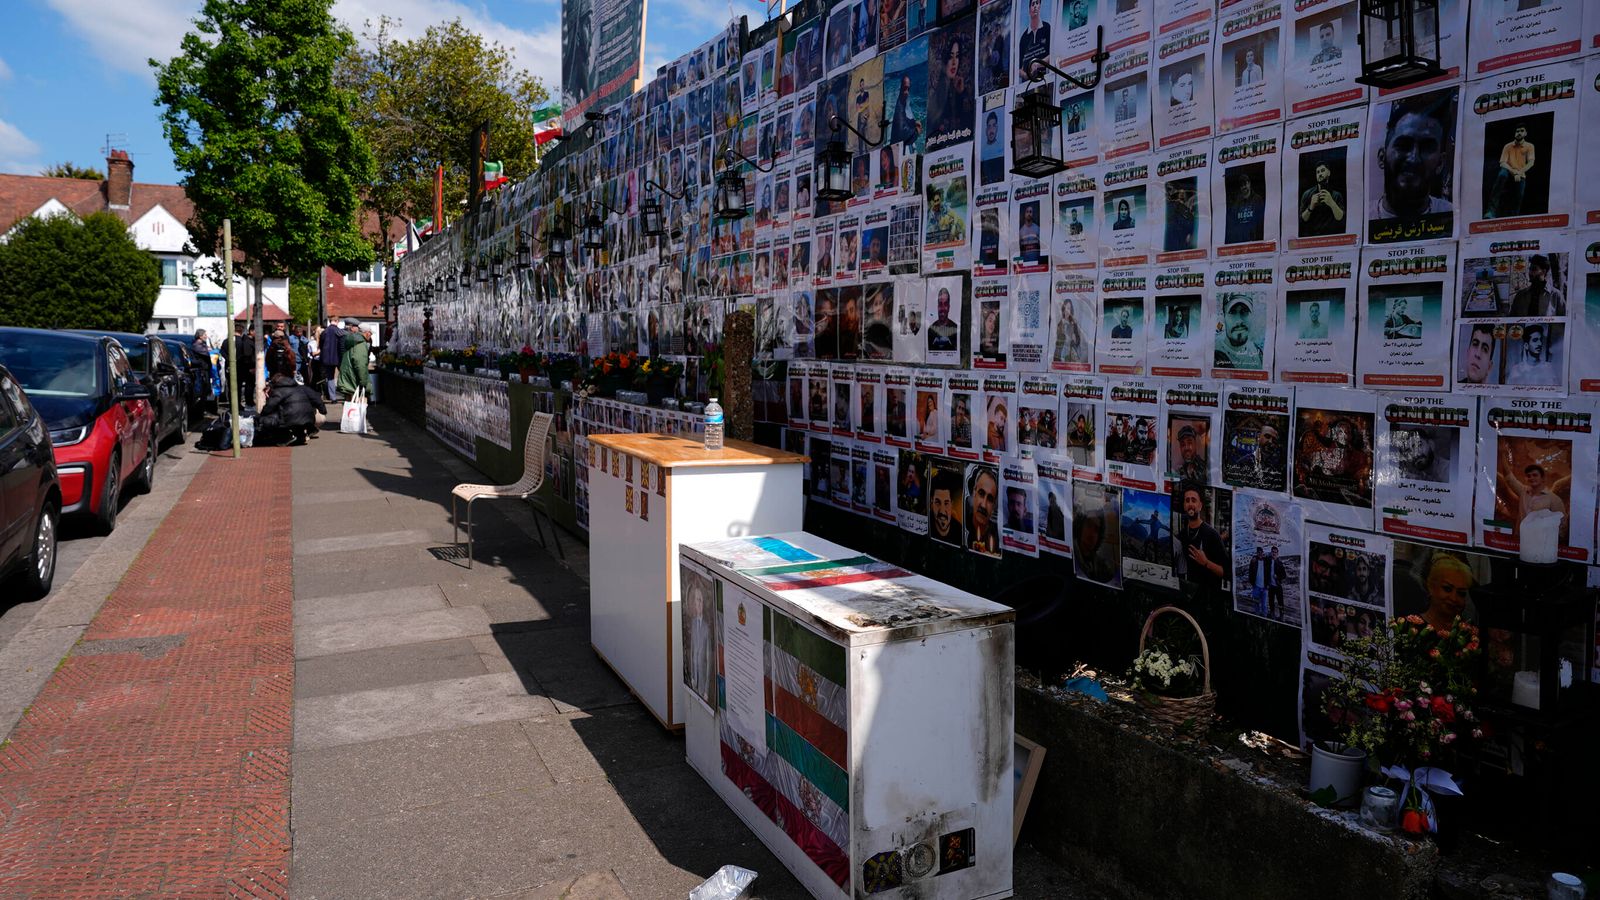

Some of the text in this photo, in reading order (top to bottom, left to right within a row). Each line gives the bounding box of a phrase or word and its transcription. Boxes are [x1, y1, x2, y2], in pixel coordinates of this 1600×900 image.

[1236, 4, 1264, 16] STOP THE
[1497, 74, 1546, 90] STOP THE
[1474, 79, 1575, 114] GENOCIDE
[1233, 134, 1260, 144] STOP THE
[1291, 122, 1359, 149] GENOCIDE
[1218, 138, 1276, 163] GENOCIDE
[1157, 153, 1207, 176] GENOCIDE
[1104, 165, 1148, 186] GENOCIDE
[1058, 178, 1096, 196] GENOCIDE
[1374, 220, 1445, 240] سید آرش قریشی
[1388, 249, 1405, 257] STOP
[1490, 240, 1540, 253] GENOCIDE
[1286, 263, 1352, 282] GENOCIDE
[1368, 255, 1447, 278] GENOCIDE
[1102, 277, 1146, 292] GENOCIDE
[1155, 273, 1204, 290] GENOCIDE
[1215, 269, 1272, 286] GENOCIDE
[1111, 386, 1157, 404] GENOCIDE
[1166, 389, 1218, 407] GENOCIDE
[1229, 393, 1288, 413] GENOCIDE
[1404, 396, 1443, 405] STOP THE
[1512, 400, 1562, 409] STOP THE
[1385, 404, 1469, 427] GENOCIDE
[1488, 408, 1592, 433] GENOCIDE
